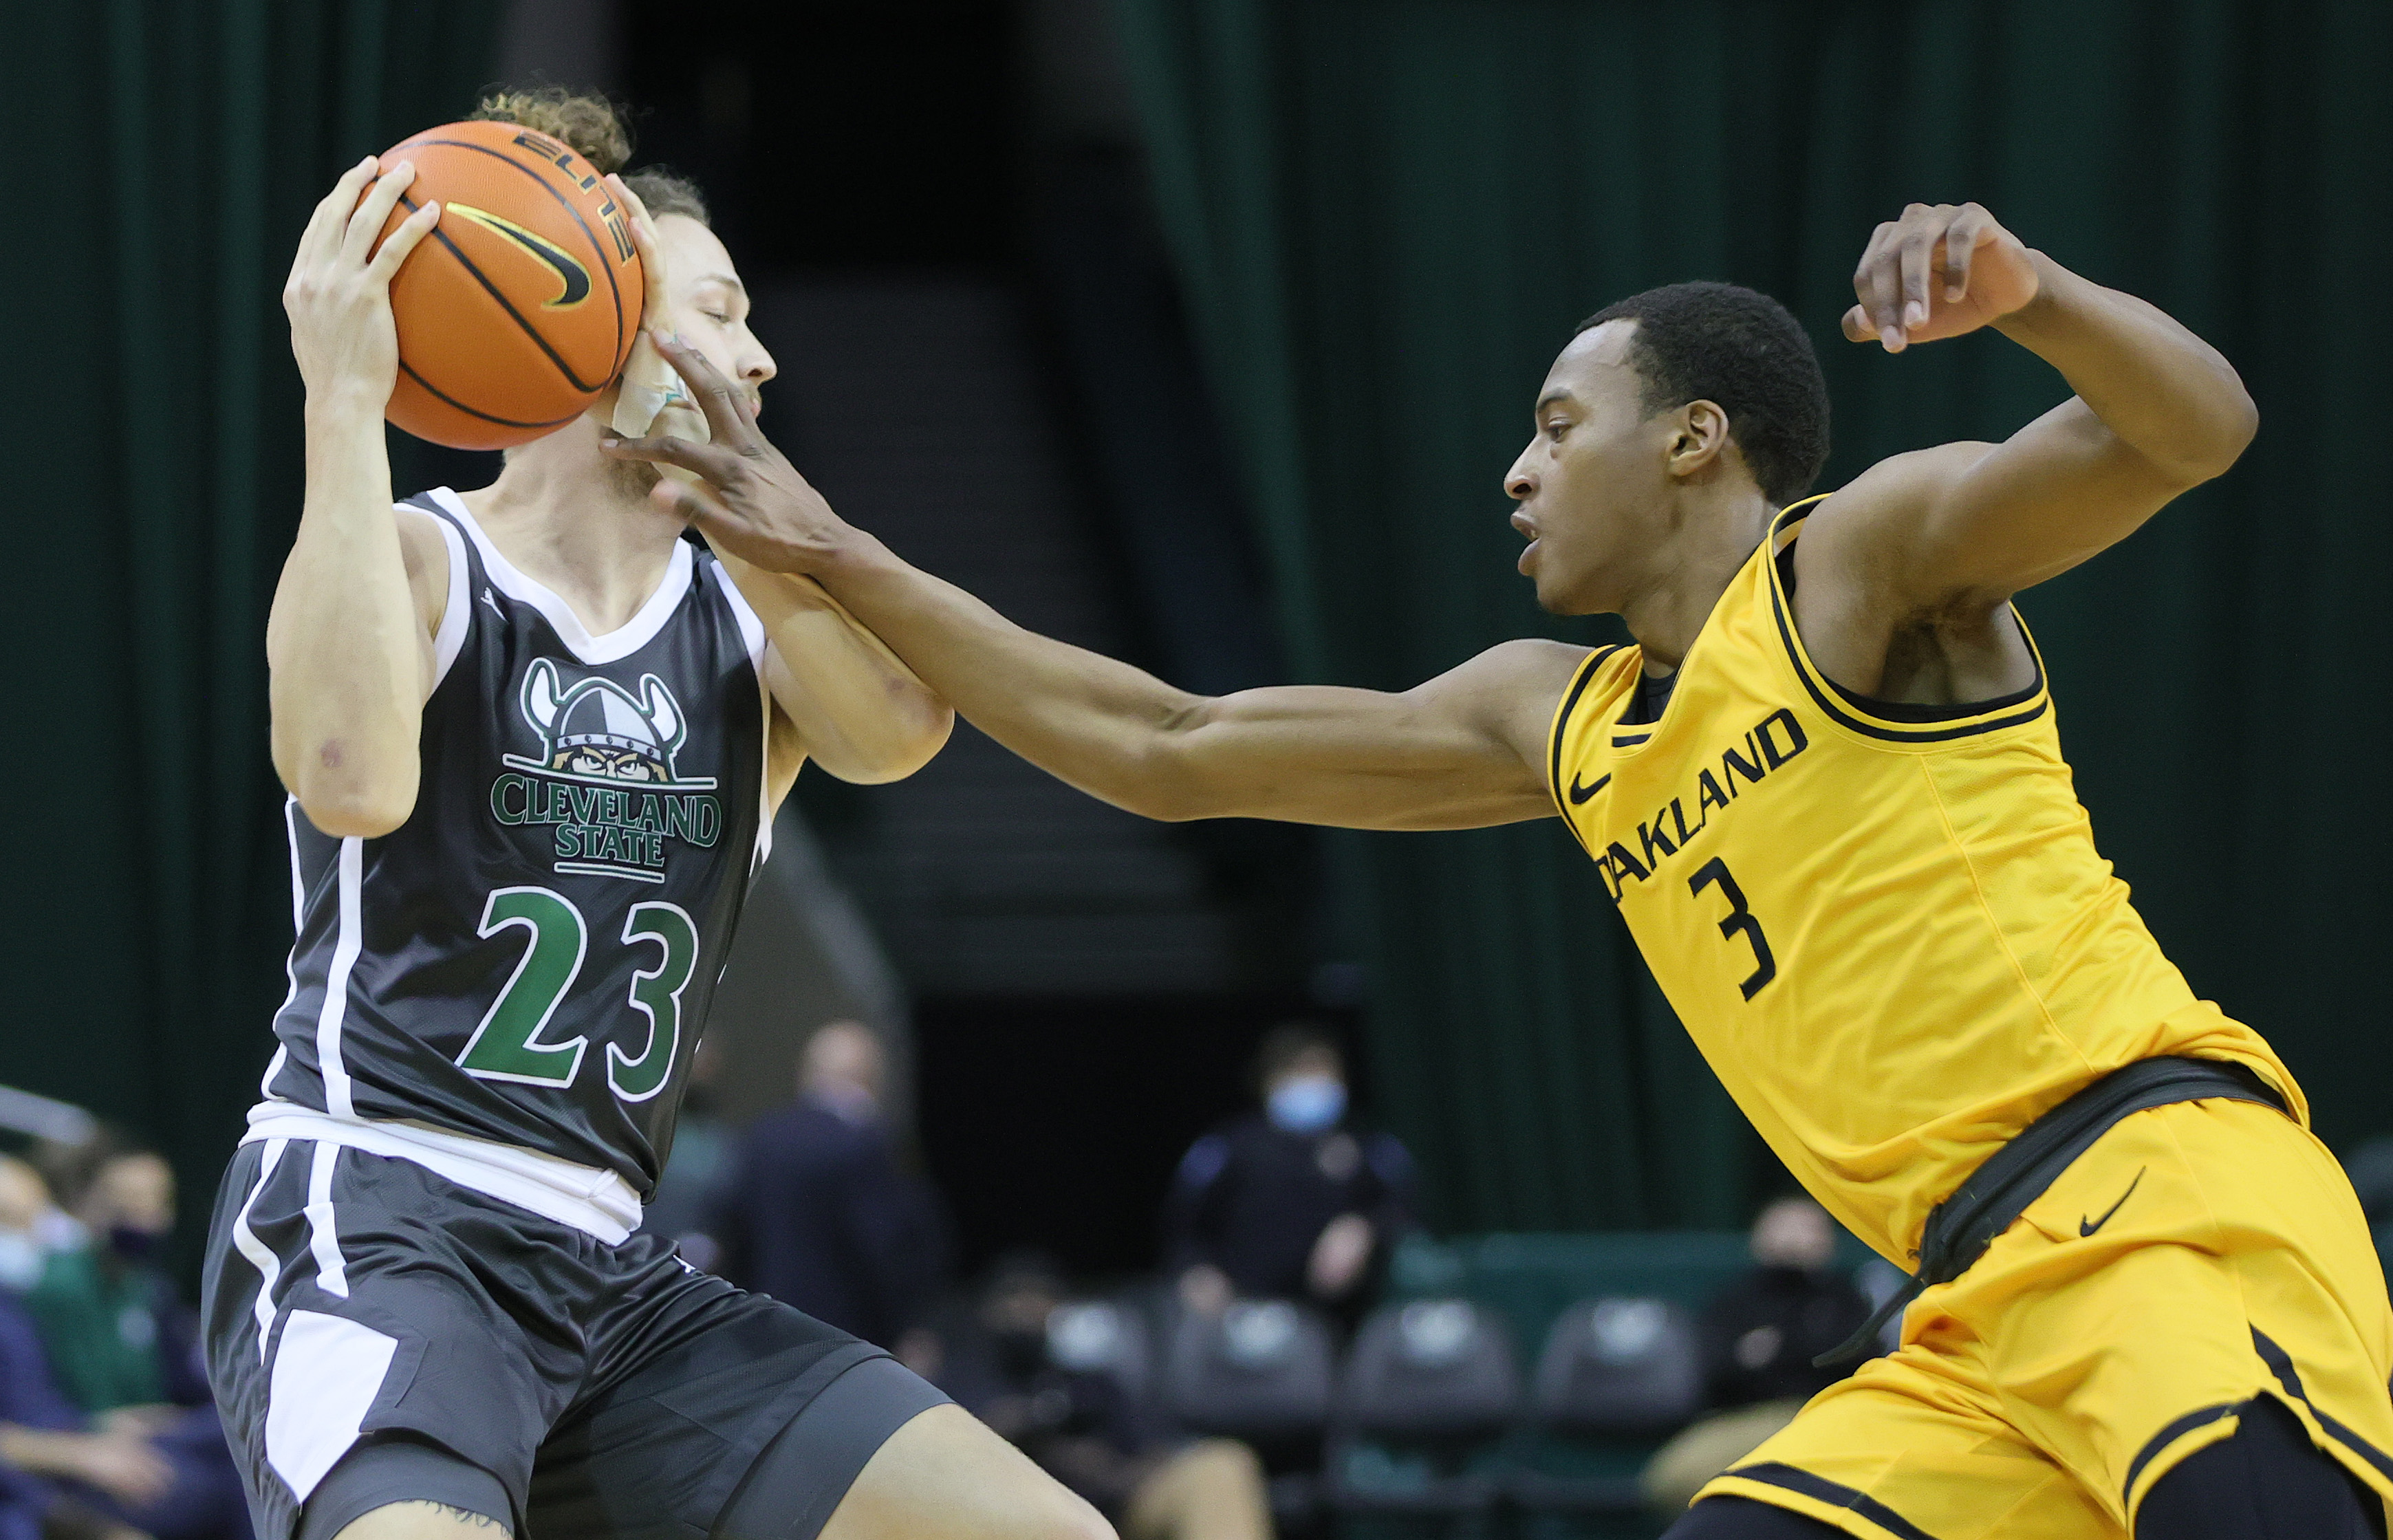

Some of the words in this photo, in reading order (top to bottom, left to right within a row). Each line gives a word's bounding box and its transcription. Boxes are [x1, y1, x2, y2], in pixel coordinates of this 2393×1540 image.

[513, 131, 636, 266] ELITE
[490, 773, 722, 847] CLEVELAND
[556, 822, 664, 867] STATE
[455, 886, 699, 1102] 23
[1688, 856, 1776, 1001] 3
